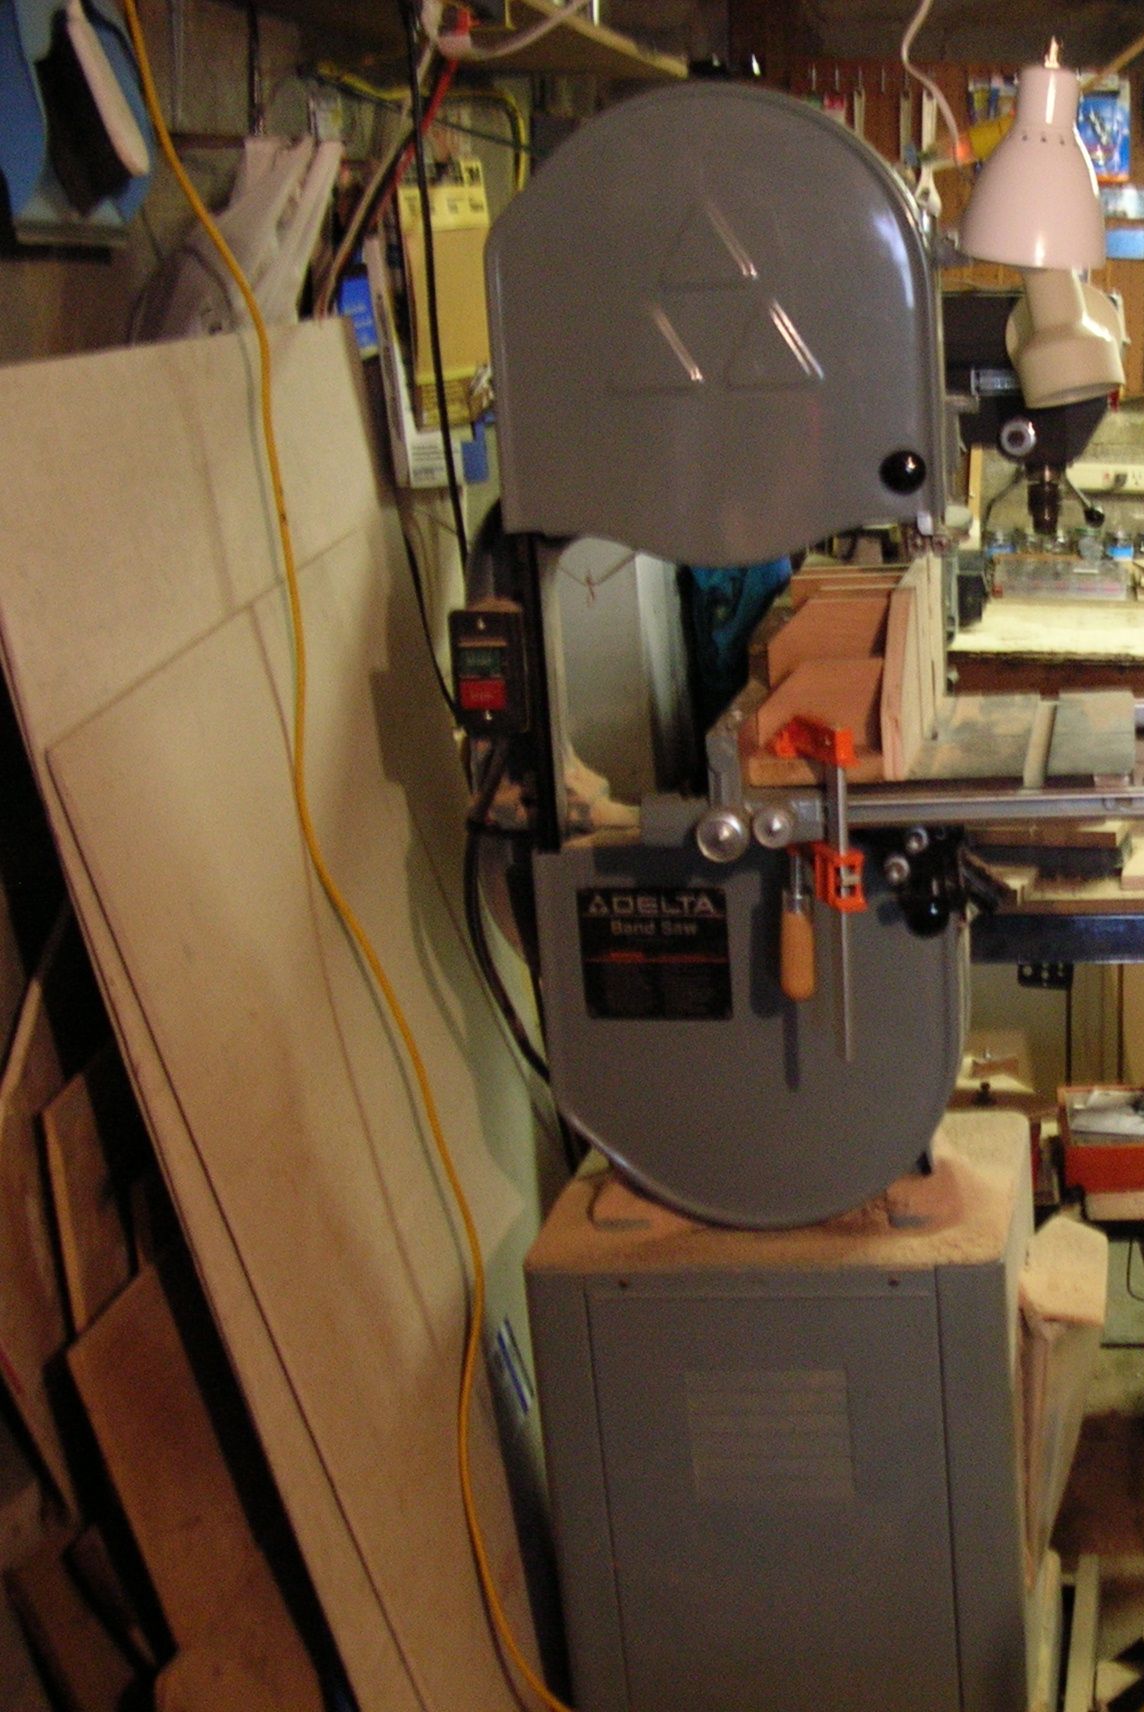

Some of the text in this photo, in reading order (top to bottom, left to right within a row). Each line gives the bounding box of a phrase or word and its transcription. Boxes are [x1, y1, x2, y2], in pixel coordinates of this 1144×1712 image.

[613, 895, 716, 914] DELTA
[611, 920, 697, 935] Band Saw
